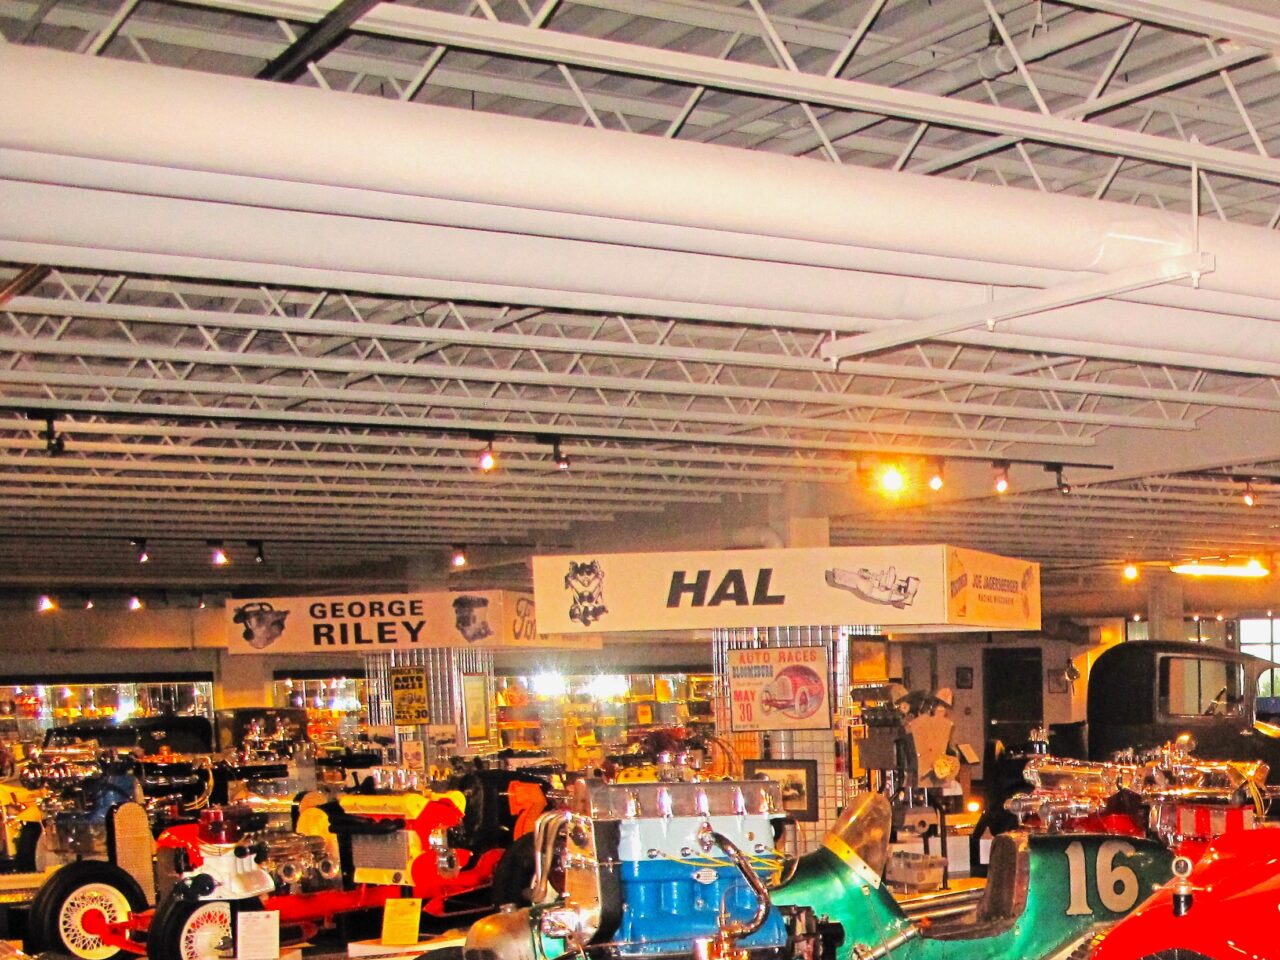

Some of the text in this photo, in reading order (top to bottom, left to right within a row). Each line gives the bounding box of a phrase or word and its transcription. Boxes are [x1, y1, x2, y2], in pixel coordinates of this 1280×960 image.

[666, 568, 785, 608] HAL
[309, 600, 426, 645] GEORGE RILEY
[739, 649, 817, 664] AUTO RACES
[394, 675, 423, 683] AUTO
[733, 690, 756, 702] MAY
[414, 709, 428, 719] 30
[739, 703, 753, 722] 30
[507, 780, 548, 841] 7
[1065, 840, 1139, 914] 16
